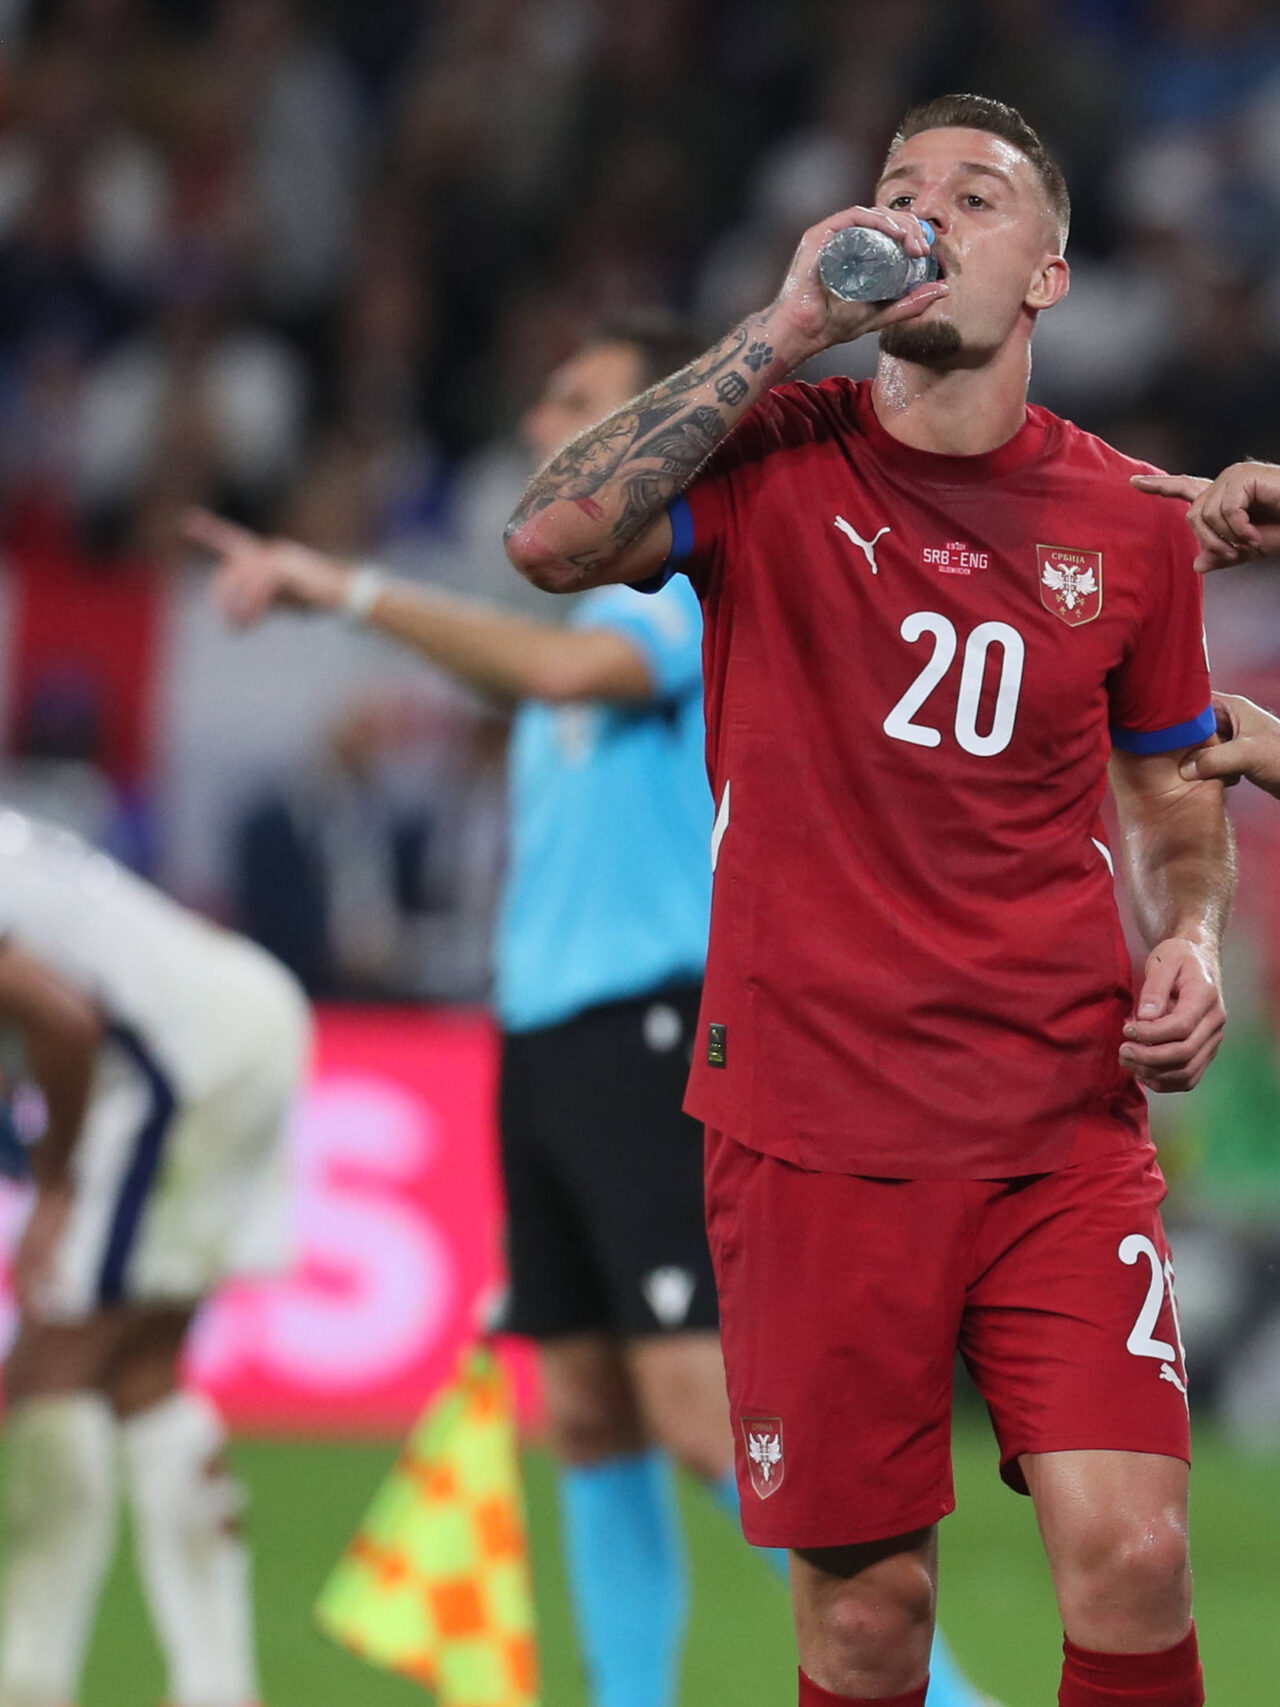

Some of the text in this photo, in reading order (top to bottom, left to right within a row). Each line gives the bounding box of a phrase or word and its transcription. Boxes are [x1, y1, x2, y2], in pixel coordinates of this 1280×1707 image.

[1051, 552, 1086, 564] СРБИЈА
[883, 611, 1025, 757] 20
[1118, 1233, 1186, 1362] 2
